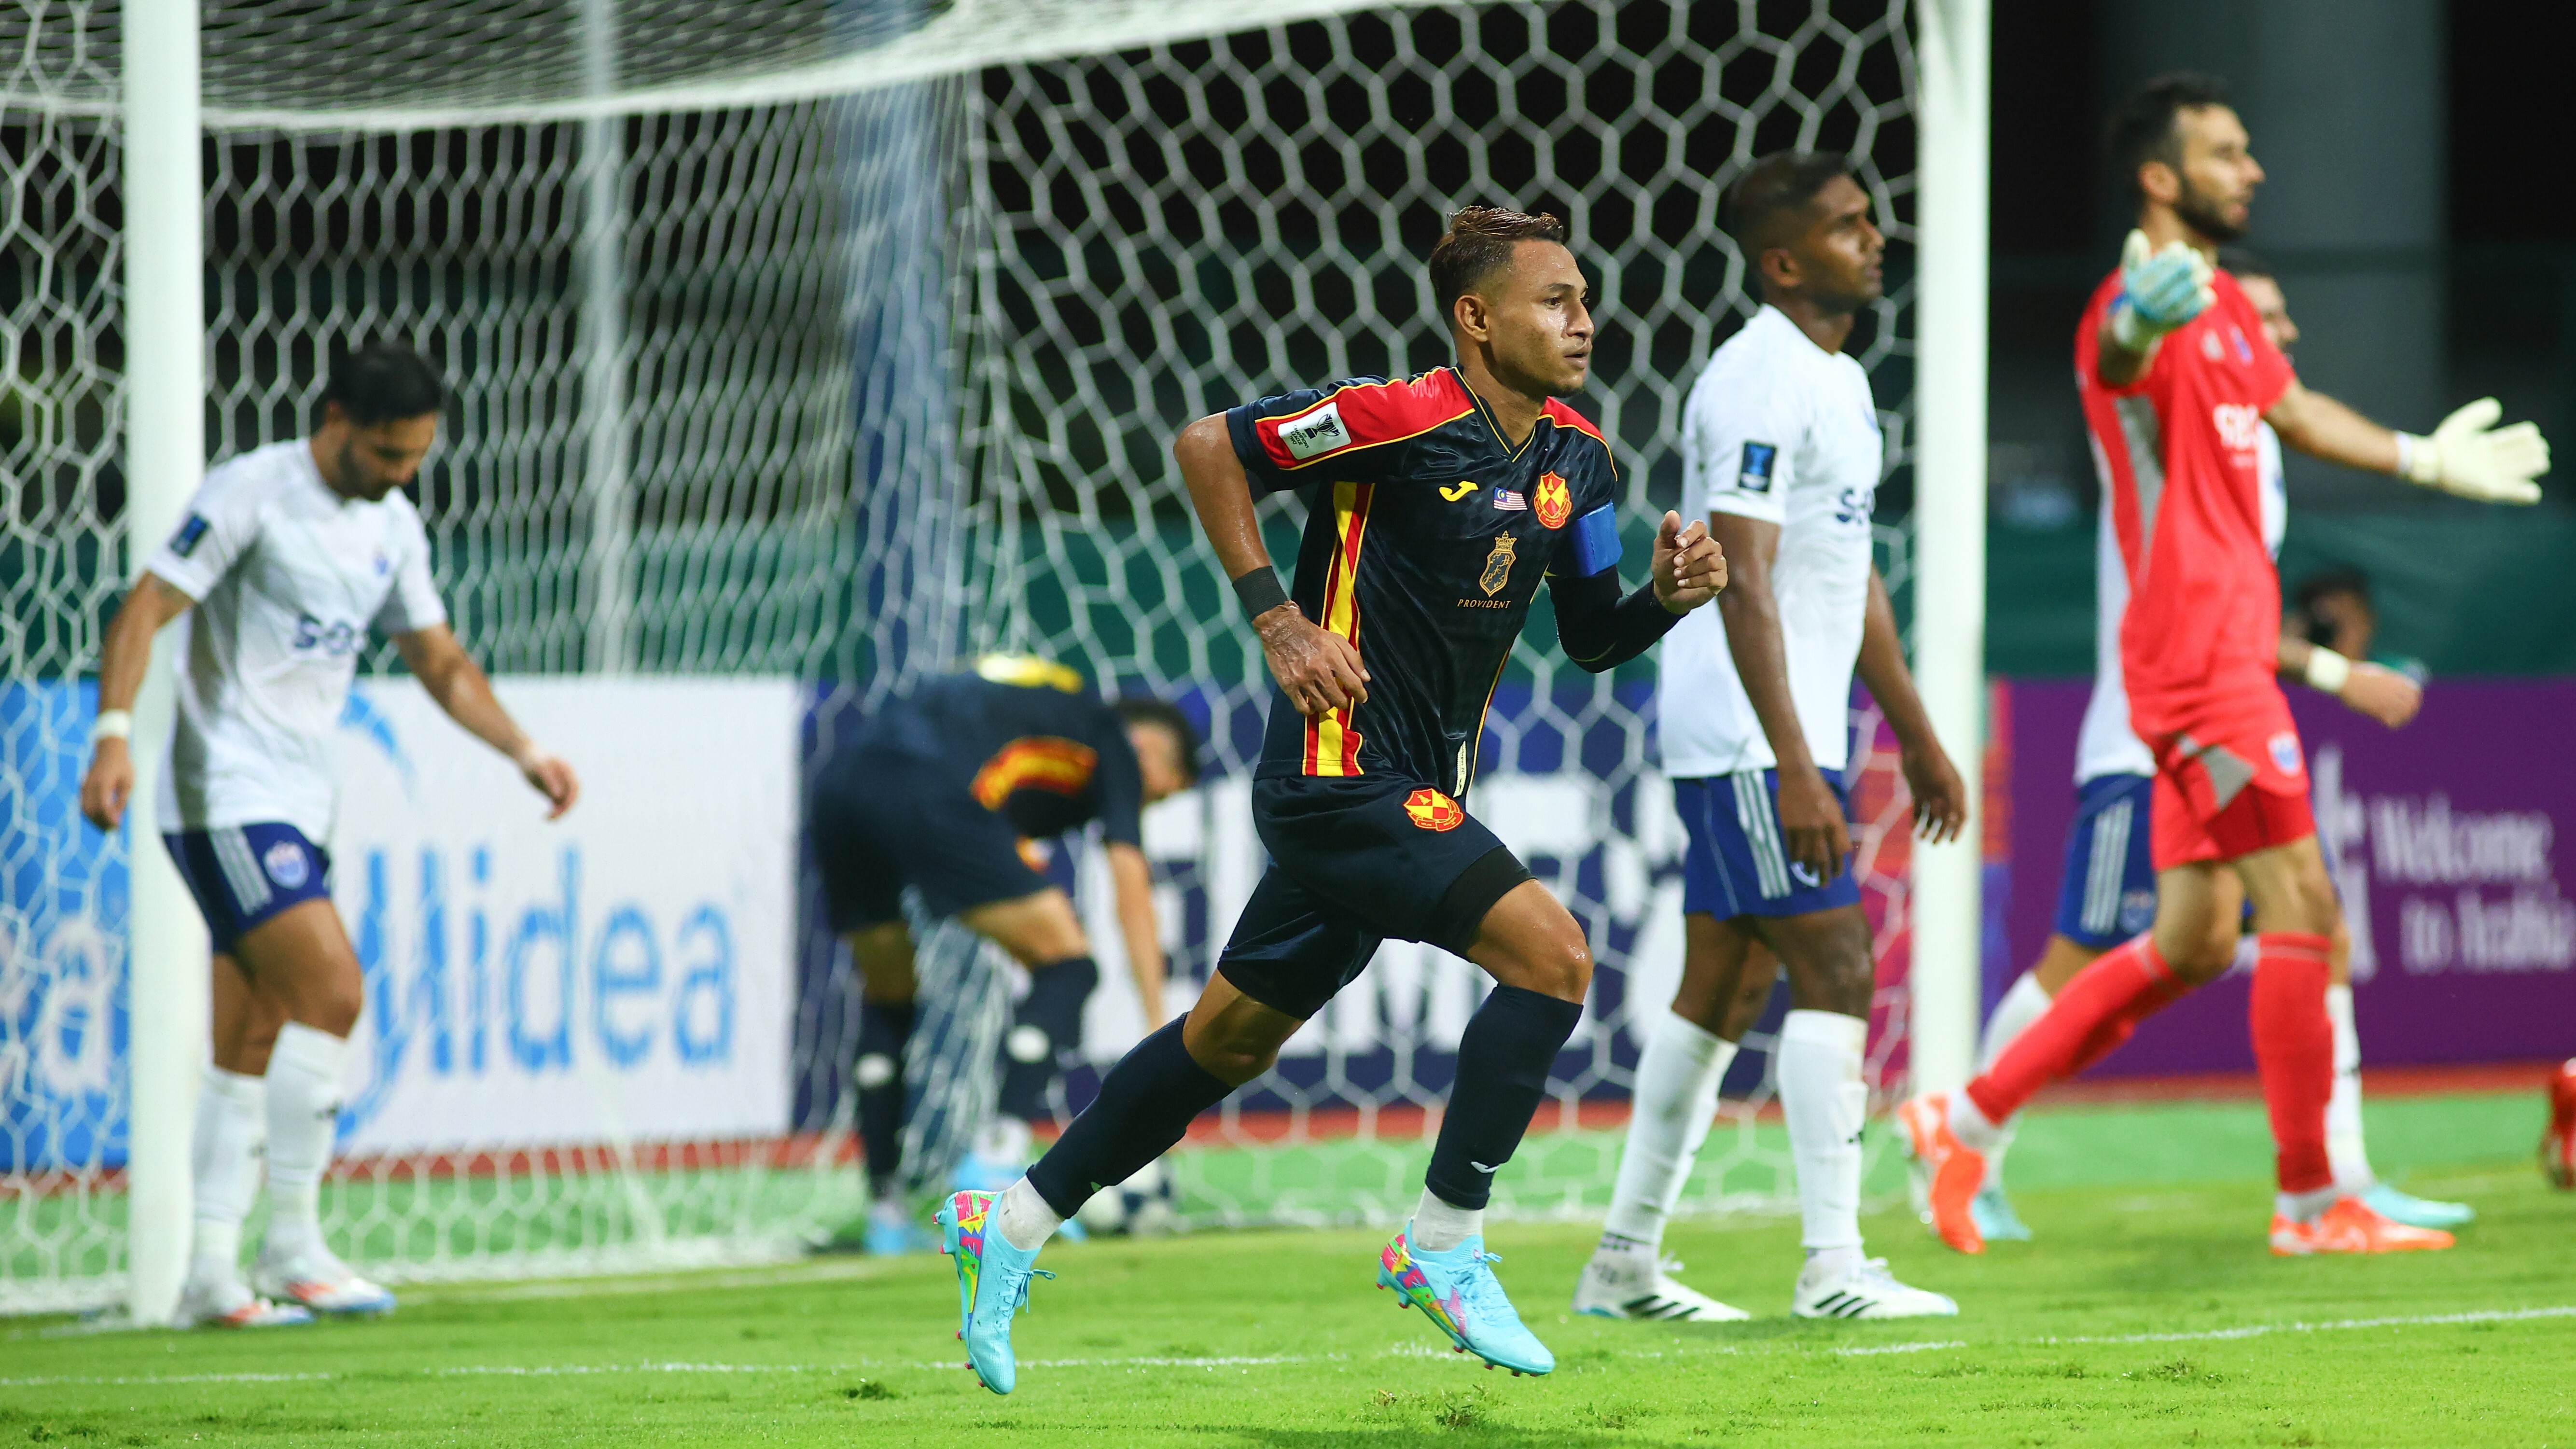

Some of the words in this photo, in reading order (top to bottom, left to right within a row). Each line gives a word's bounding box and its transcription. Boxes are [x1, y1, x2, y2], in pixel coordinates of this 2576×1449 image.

[1291, 431, 1303, 446] LEAGUE
[1294, 425, 1309, 449] CHAMPIONS
[1457, 599, 1511, 609] PROVIDENT
[2374, 794, 2551, 882] Welcome
[355, 841, 738, 1075] Midea
